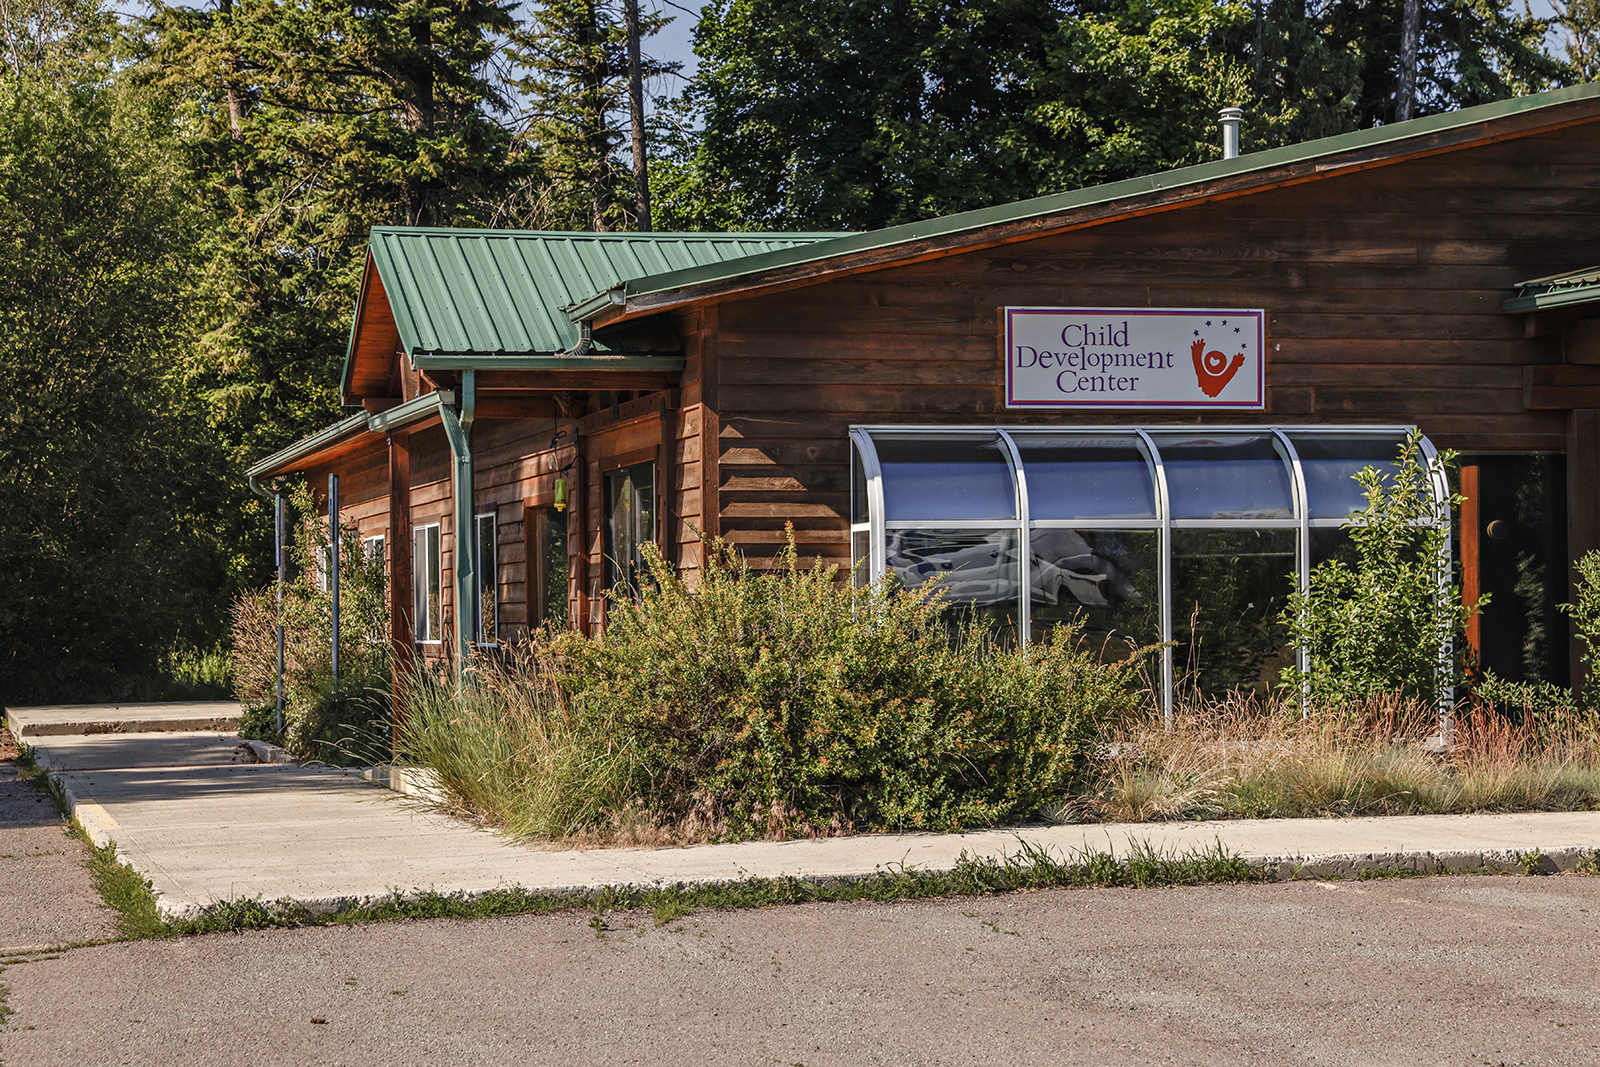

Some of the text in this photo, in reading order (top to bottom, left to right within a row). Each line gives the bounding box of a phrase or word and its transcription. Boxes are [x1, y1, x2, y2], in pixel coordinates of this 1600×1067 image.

[1061, 321, 1130, 347] Child
[1015, 346, 1174, 373] Development
[1056, 370, 1139, 393] Center
